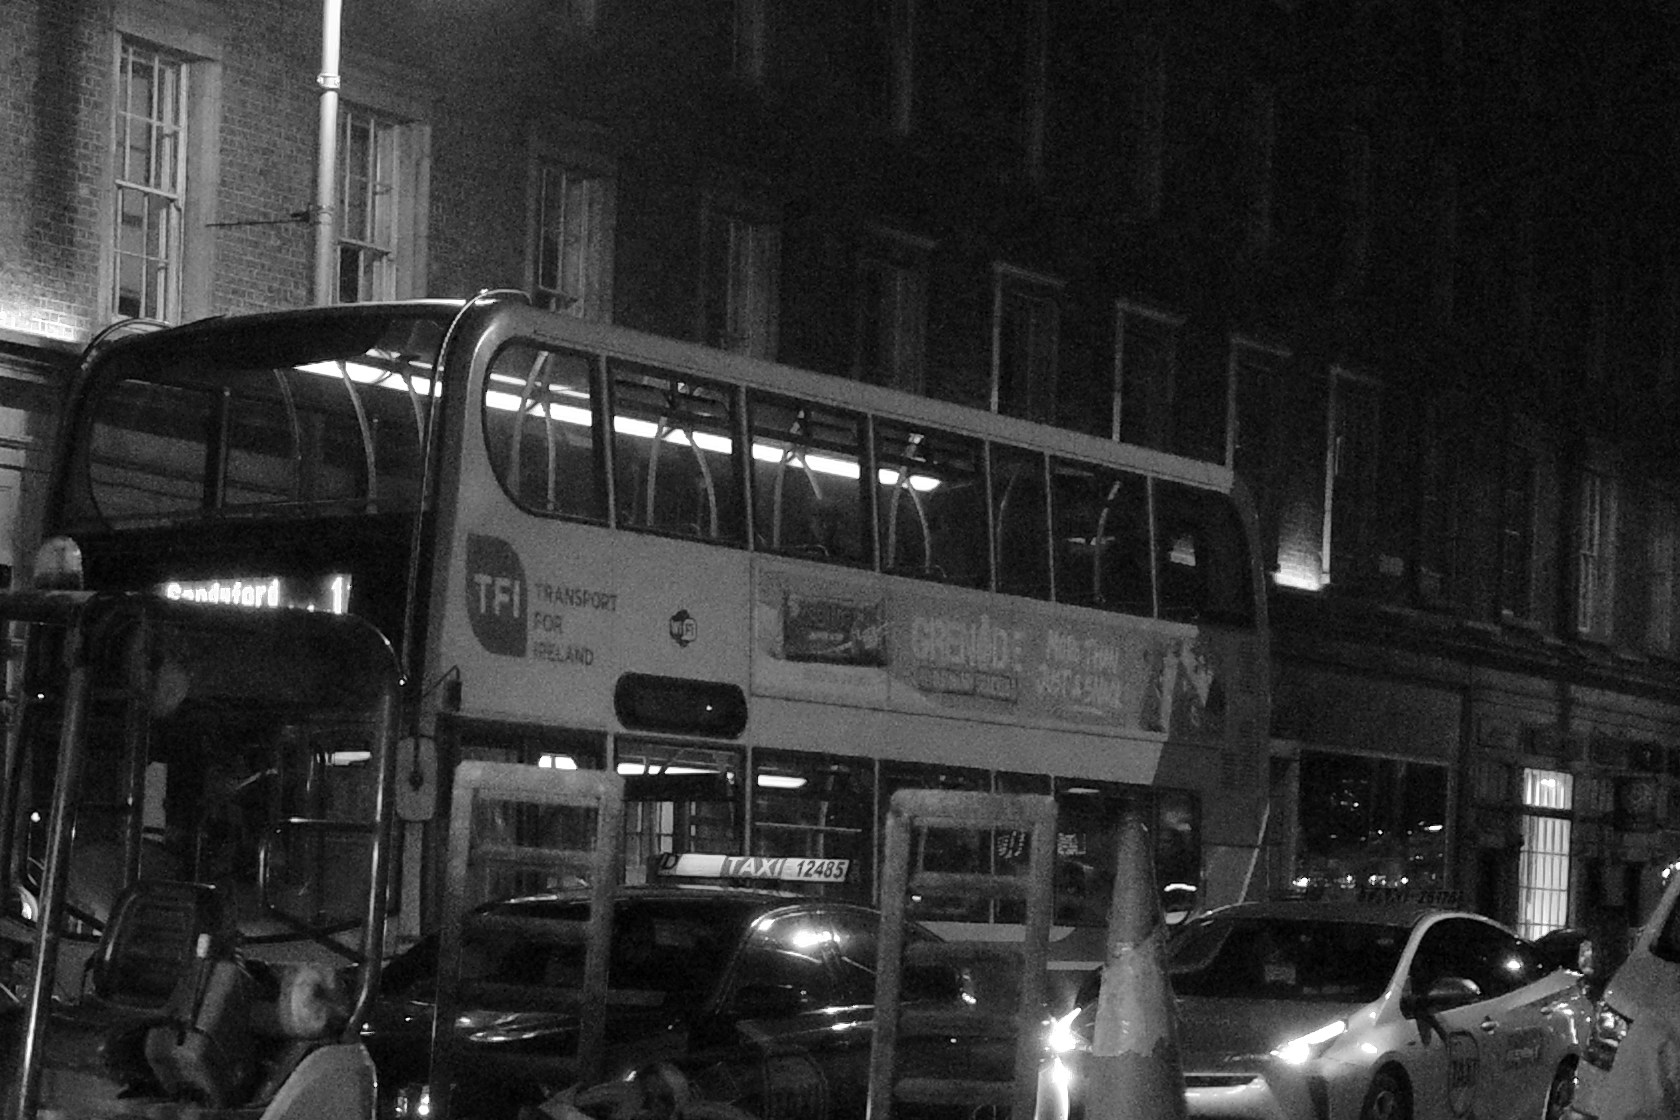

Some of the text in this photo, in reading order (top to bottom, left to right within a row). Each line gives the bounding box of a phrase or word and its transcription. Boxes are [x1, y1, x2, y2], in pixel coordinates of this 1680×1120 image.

[473, 572, 521, 619] TFI
[534, 582, 618, 611] TRANSPORT
[533, 611, 564, 635] FOR
[533, 641, 595, 666] IRELAND
[727, 856, 846, 879] TAXI 12485
